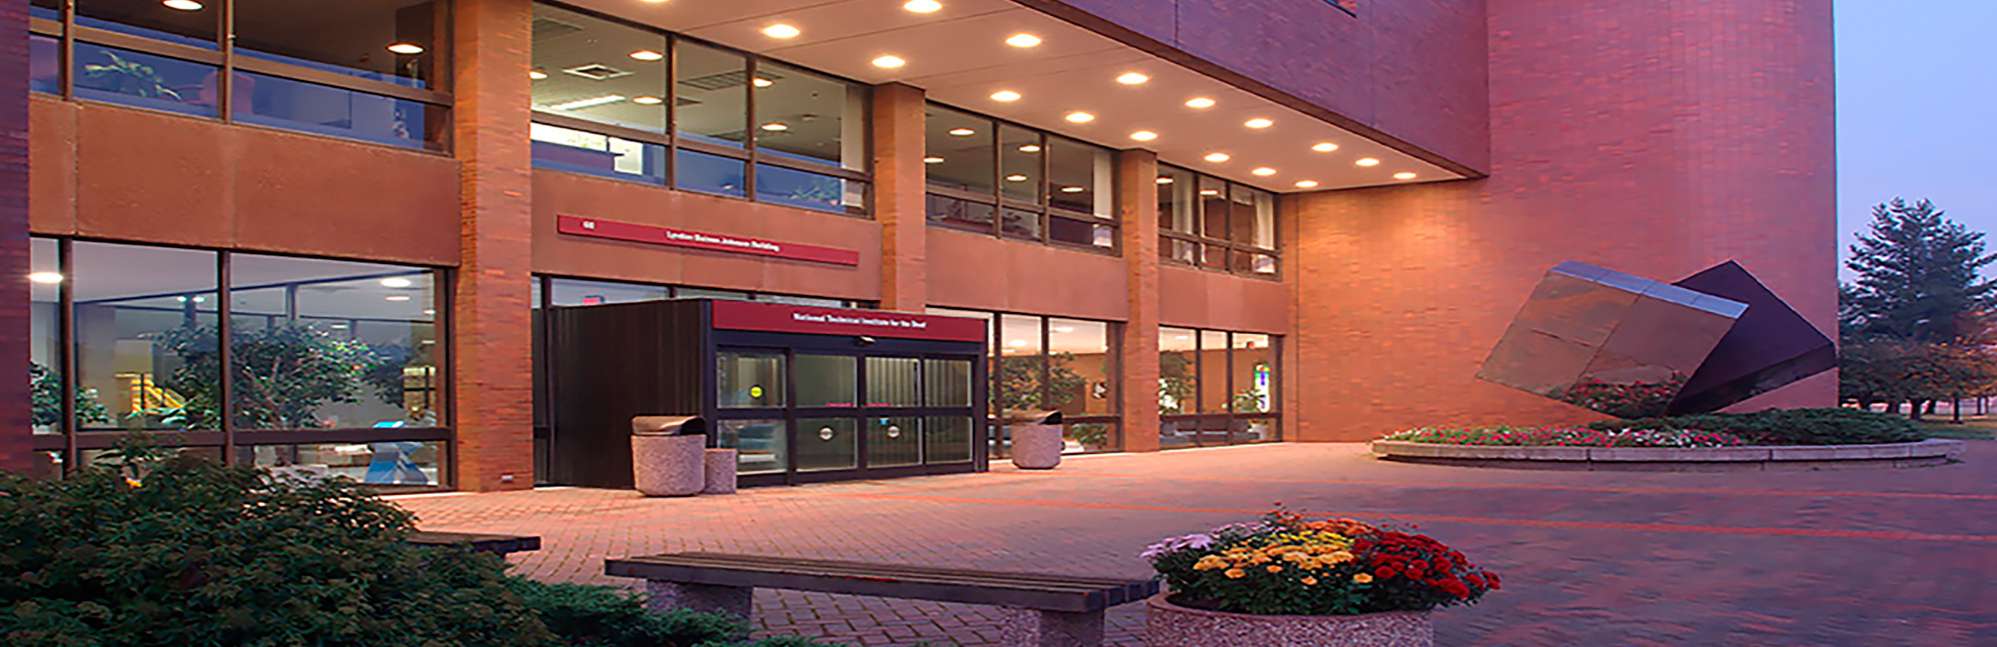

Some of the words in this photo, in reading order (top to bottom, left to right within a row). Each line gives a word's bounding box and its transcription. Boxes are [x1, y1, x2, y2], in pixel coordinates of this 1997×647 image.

[722, 237, 750, 246] Johnson
[751, 241, 780, 252] Building
[793, 313, 825, 322] National
[826, 314, 860, 323] Technical
[862, 317, 889, 326] Institute
[911, 320, 927, 328] Deaf
